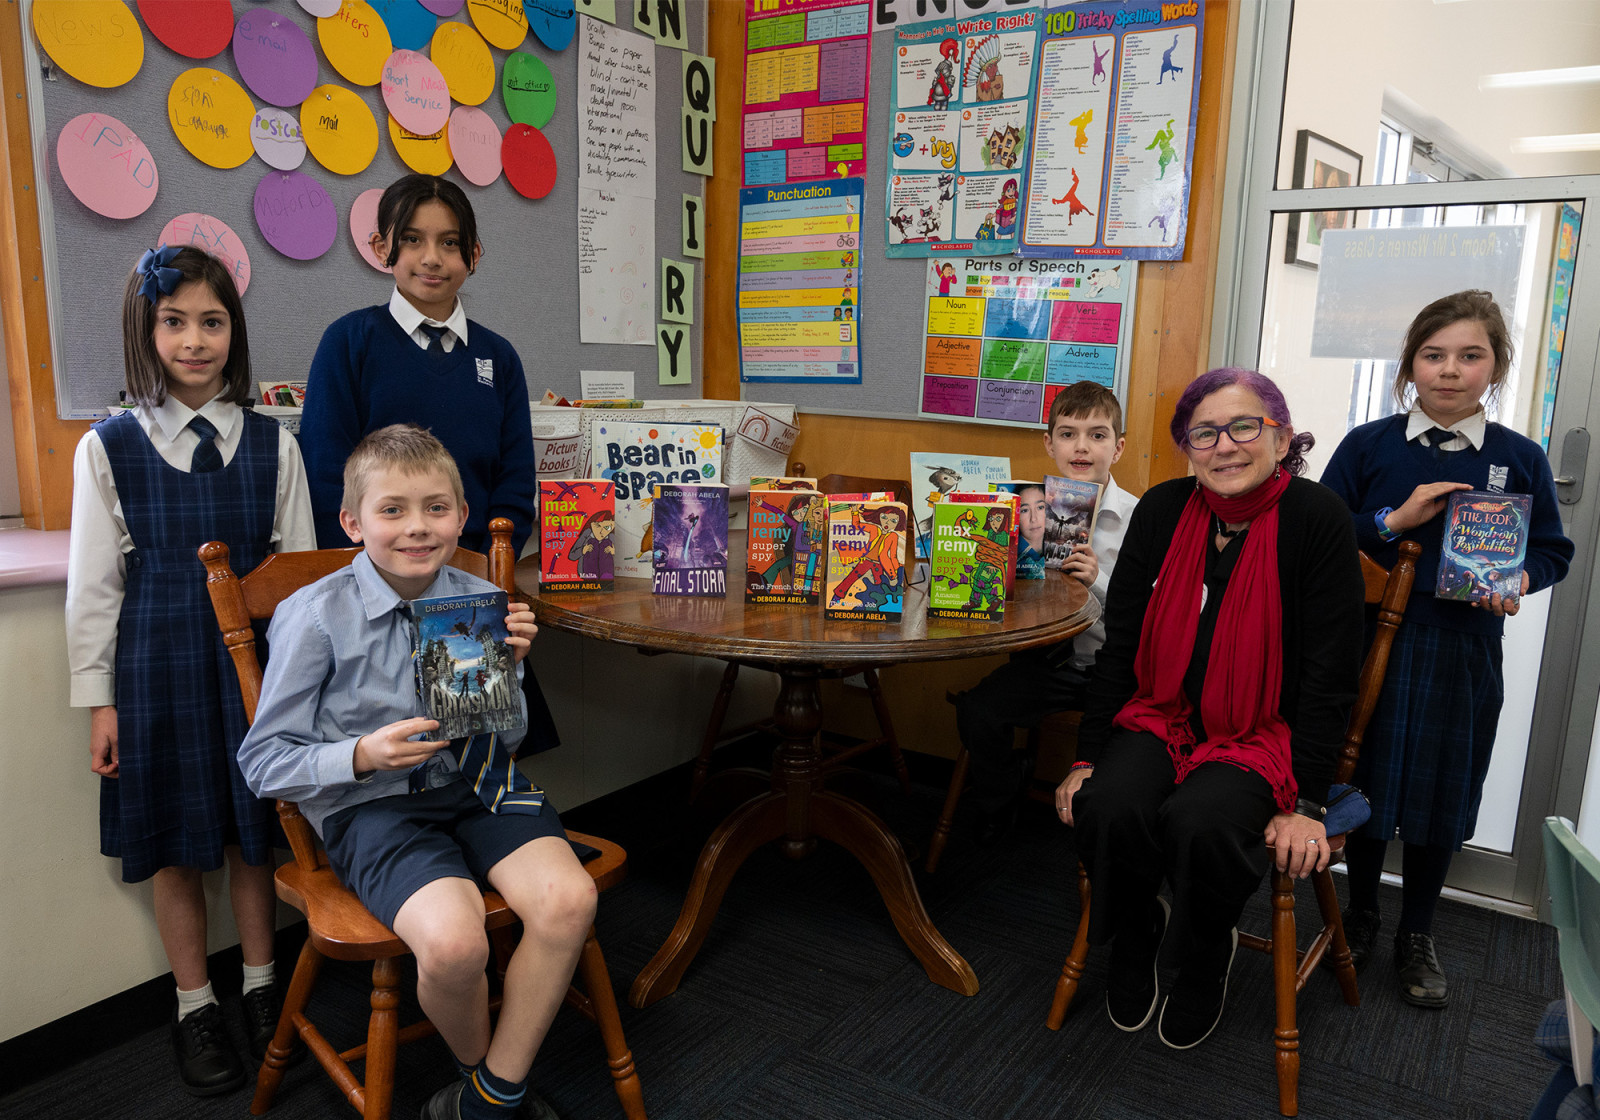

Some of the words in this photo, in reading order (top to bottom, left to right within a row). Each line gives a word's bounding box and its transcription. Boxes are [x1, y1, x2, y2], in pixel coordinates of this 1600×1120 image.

[957, 19, 992, 35] Write
[996, 12, 1036, 31] Right!
[1044, 10, 1076, 35] 100
[1078, 10, 1116, 29] Tricky
[1115, 8, 1161, 28] Spelling
[1161, 0, 1198, 21] Words
[404, 91, 444, 110] Service
[930, 136, 957, 169] ing
[767, 186, 832, 202] Punctuation
[965, 259, 1002, 271] Parts
[1008, 259, 1023, 271] of
[1029, 259, 1085, 275] Speech
[946, 299, 967, 308] Noun
[1076, 304, 1097, 315] Verb
[936, 340, 970, 353] Adjective
[1000, 342, 1029, 354] Article
[1065, 347, 1100, 359] Adverb
[931, 378, 969, 392] Preposition
[986, 382, 1034, 397] Conjunction
[545, 442, 578, 456] Picture
[606, 442, 676, 471] Bear
[678, 445, 697, 466] in
[539, 457, 570, 471] books
[663, 490, 697, 498] DEBORAH
[545, 501, 578, 511] max
[545, 515, 584, 530] remy
[753, 511, 785, 524] max
[1462, 511, 1482, 523] THE
[1485, 513, 1513, 526] BOOK
[545, 531, 579, 541] super
[752, 526, 791, 543] remy
[833, 523, 866, 536] max
[938, 524, 972, 537] max
[1457, 524, 1519, 545] Wondrous
[545, 541, 566, 550] spy
[751, 542, 786, 552] super
[832, 539, 871, 556] remy
[937, 539, 977, 556] remy
[1453, 535, 1516, 556] Possibilities
[751, 553, 772, 562] spy
[831, 555, 866, 566] super
[936, 555, 971, 566] super
[830, 565, 854, 576] spy
[936, 565, 957, 576] spy
[653, 571, 682, 593] FINAL
[687, 570, 726, 593] STORM
[425, 602, 467, 613] DEBORAH
[469, 599, 496, 607] ABELA
[756, 595, 785, 603] DEBORAH
[786, 596, 807, 604] ABELA
[934, 598, 970, 606] Experiment
[834, 611, 864, 620] DEBORAH
[865, 612, 886, 620] ABELA
[939, 610, 968, 619] DEBORAH
[970, 611, 990, 620] ABELA
